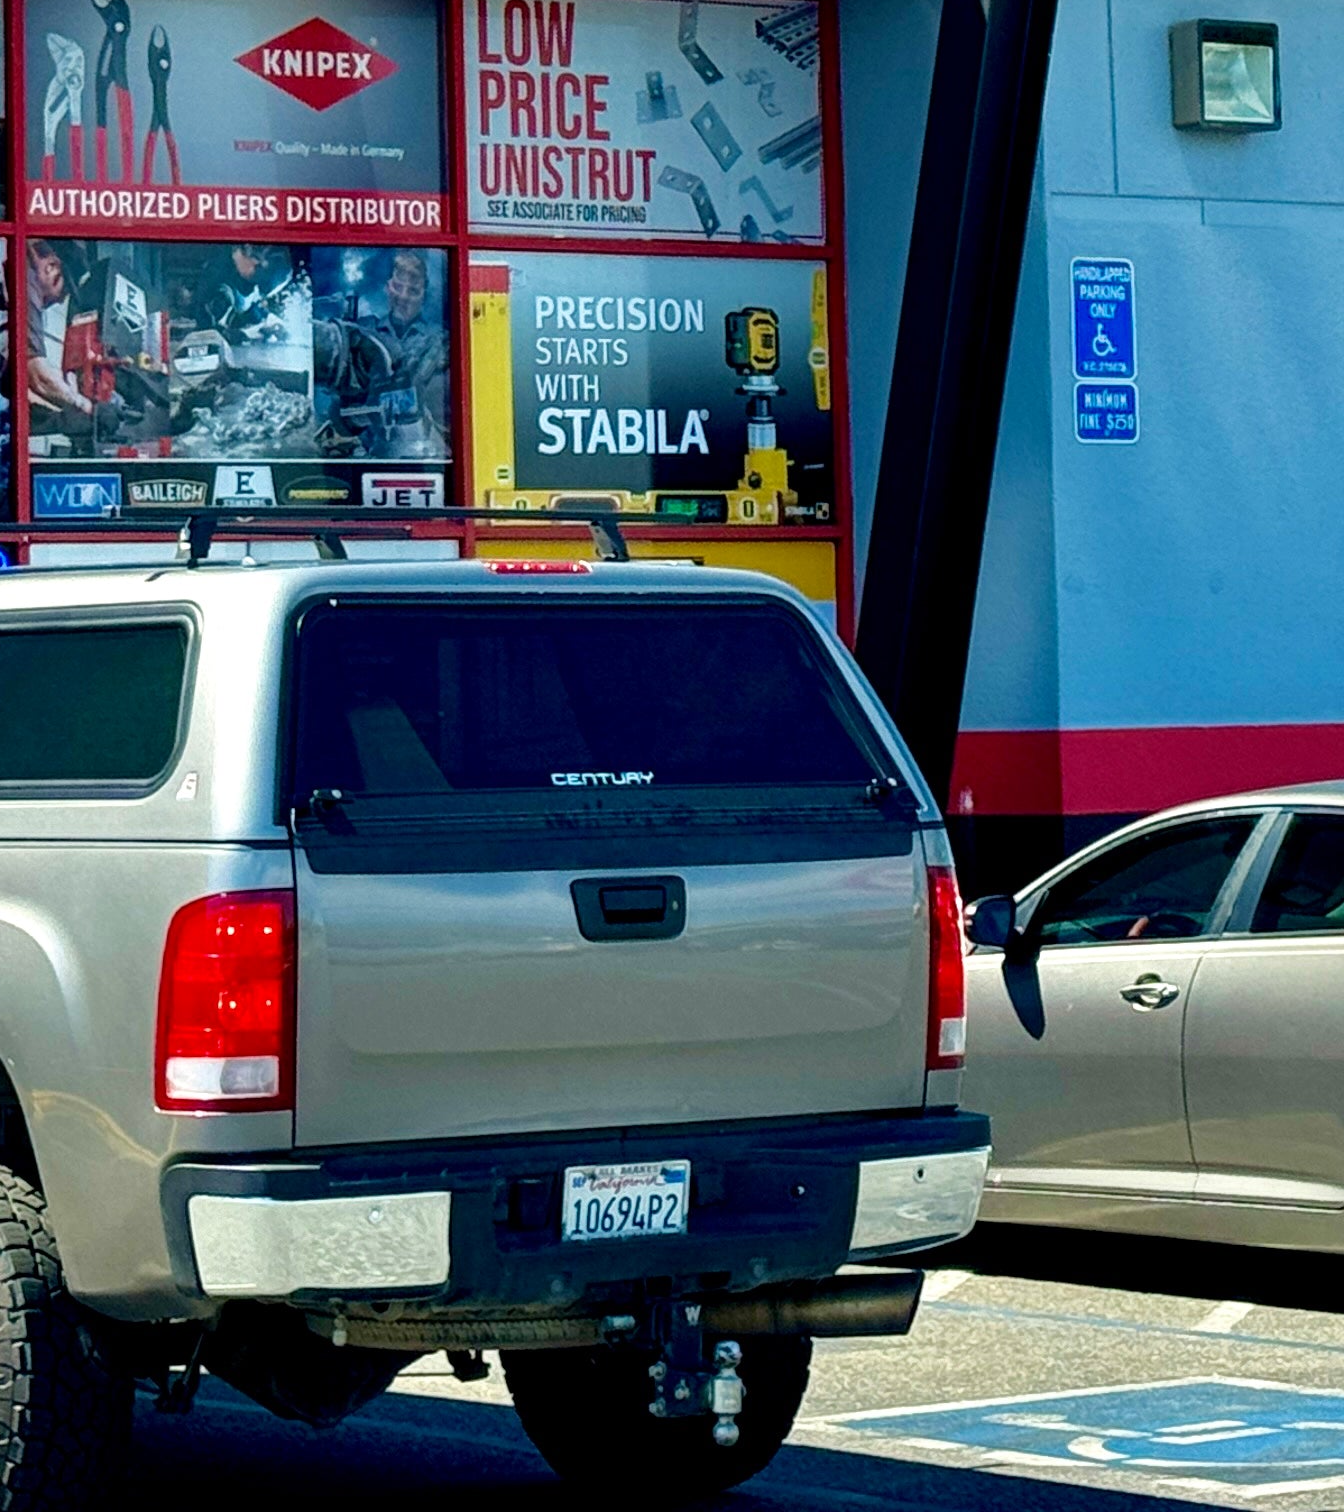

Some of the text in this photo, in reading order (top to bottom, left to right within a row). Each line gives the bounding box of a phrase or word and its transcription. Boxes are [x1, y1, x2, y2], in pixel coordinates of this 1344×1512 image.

[262, 48, 373, 80] KNIPEX
[479, 69, 611, 142] PRICE
[320, 143, 349, 156] Made
[479, 143, 656, 202] UNISTRUT
[29, 187, 442, 227] AUTHORIZED PLIERS DISTRIBUTOR
[487, 200, 646, 224] SEE ASSOCIATE FOR PRICING
[535, 296, 705, 332] PRECISION
[1089, 302, 1117, 318] ONLY
[535, 338, 629, 365] STARTS
[535, 374, 600, 402] WITH
[1084, 393, 1128, 407] MINIMUM
[1080, 413, 1101, 429] FINE
[132, 482, 204, 502] BAILEIGH
[371, 489, 437, 507] JET
[550, 771, 655, 786] CENTURY
[571, 1194, 678, 1234] 10694P2
